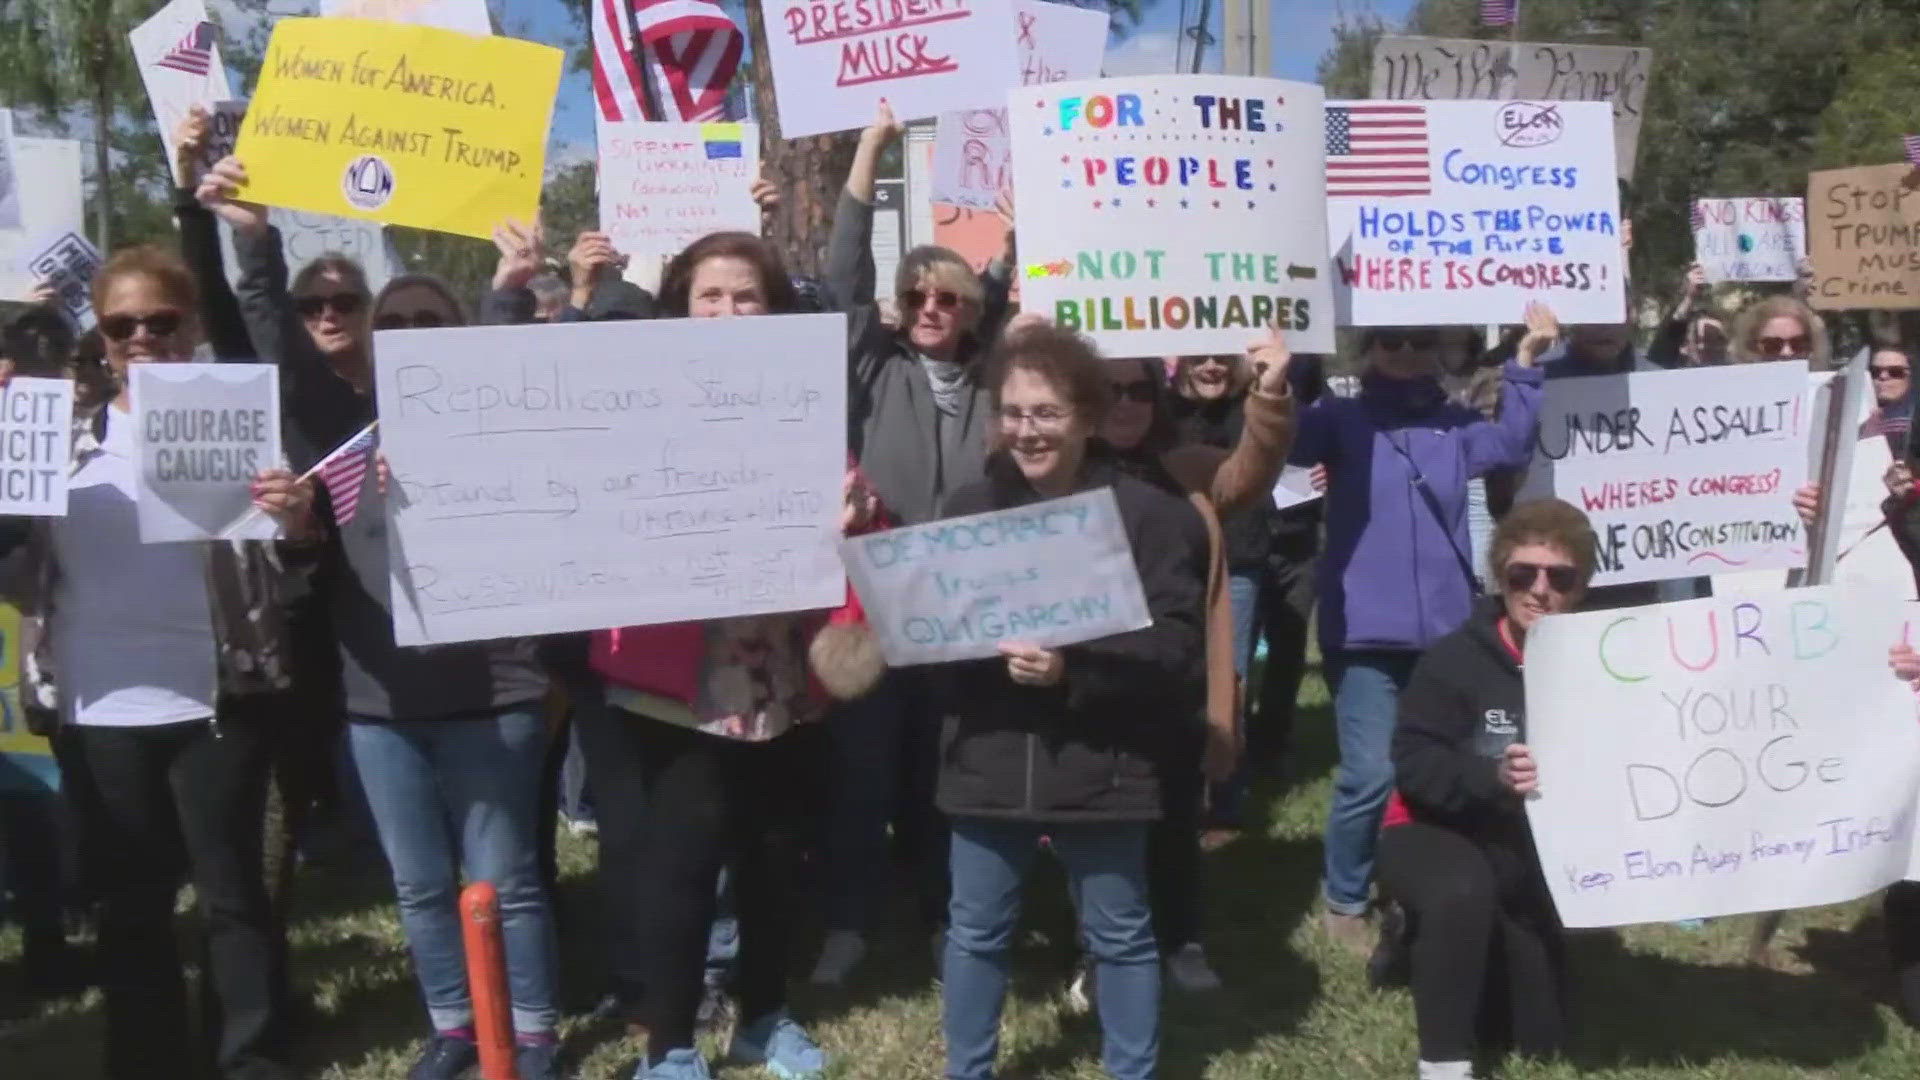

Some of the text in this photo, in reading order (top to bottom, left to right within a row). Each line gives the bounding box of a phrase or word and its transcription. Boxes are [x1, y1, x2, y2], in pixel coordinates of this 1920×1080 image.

[837, 33, 950, 82] MUSK
[1059, 94, 1266, 132] FOR THE
[1083, 157, 1254, 190] PEOPLE
[1360, 205, 1465, 239] HOLDS
[1077, 250, 1280, 284] NOT THE
[1337, 254, 1433, 291] WHERE
[1445, 260, 1473, 290] IS
[1055, 296, 1310, 332] BILLIONARES
[394, 360, 663, 437] Republicans
[146, 409, 266, 442] COURAGE
[1537, 407, 1654, 460] UNDER
[155, 448, 258, 482] CAUCUS
[1632, 519, 1676, 562] OUR
[1599, 600, 1841, 683] CURB
[1661, 682, 1801, 741] YOUR
[1624, 848, 1683, 880] Elon
